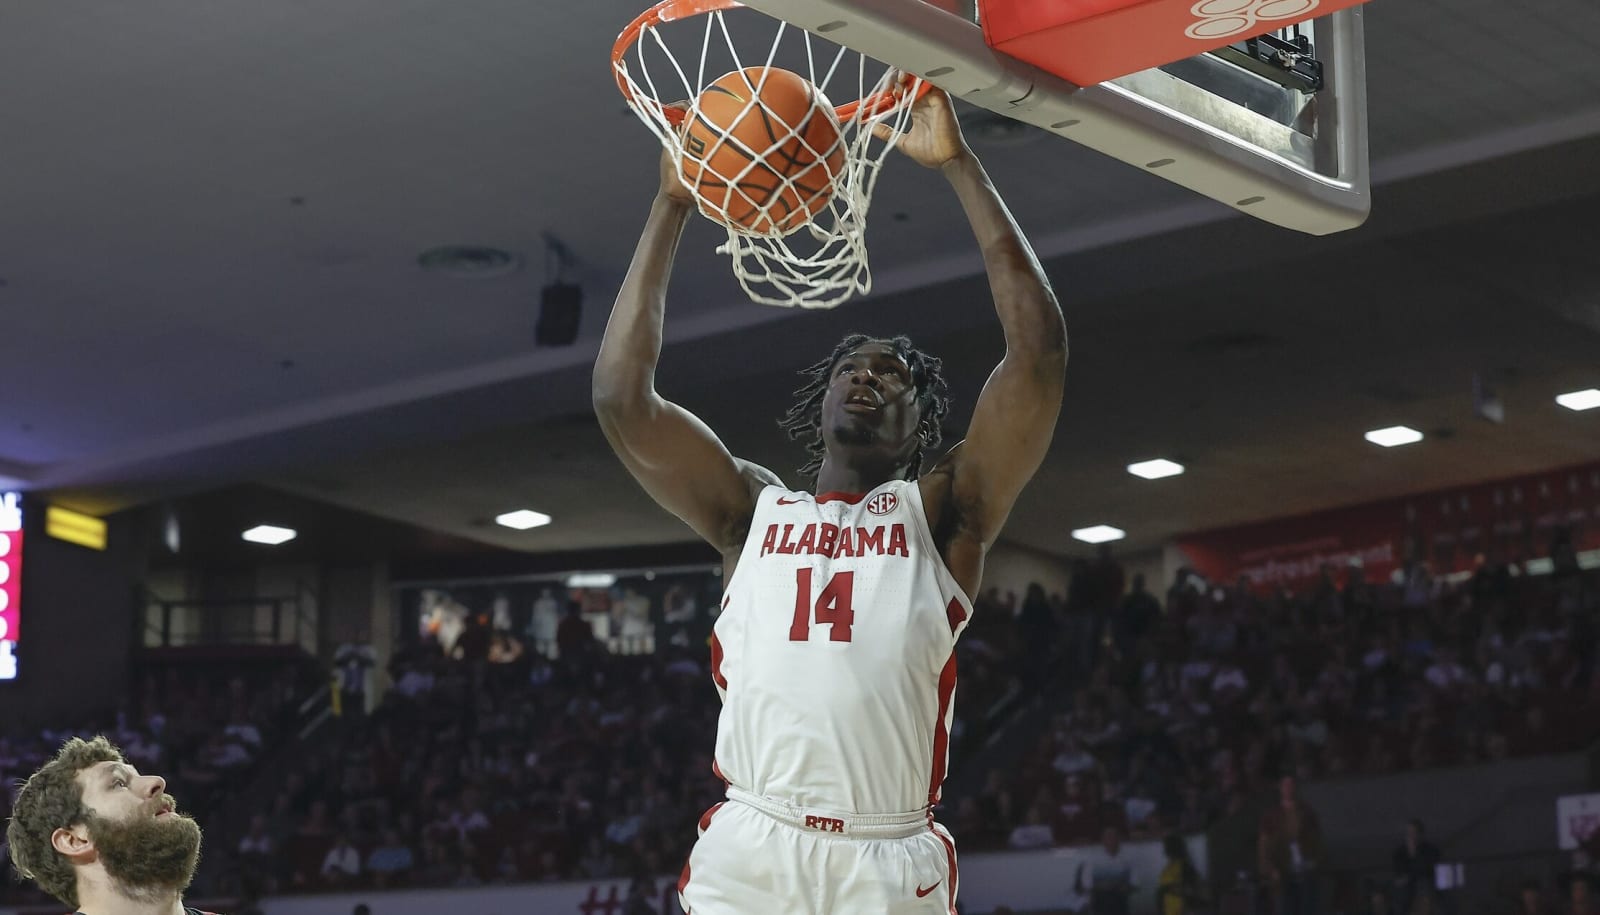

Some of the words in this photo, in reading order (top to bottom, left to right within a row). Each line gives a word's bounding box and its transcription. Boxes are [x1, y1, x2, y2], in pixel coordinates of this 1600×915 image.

[867, 493, 897, 514] SEC
[760, 522, 910, 559] ALABAMA
[789, 567, 854, 642] 14
[805, 815, 845, 833] RTR
